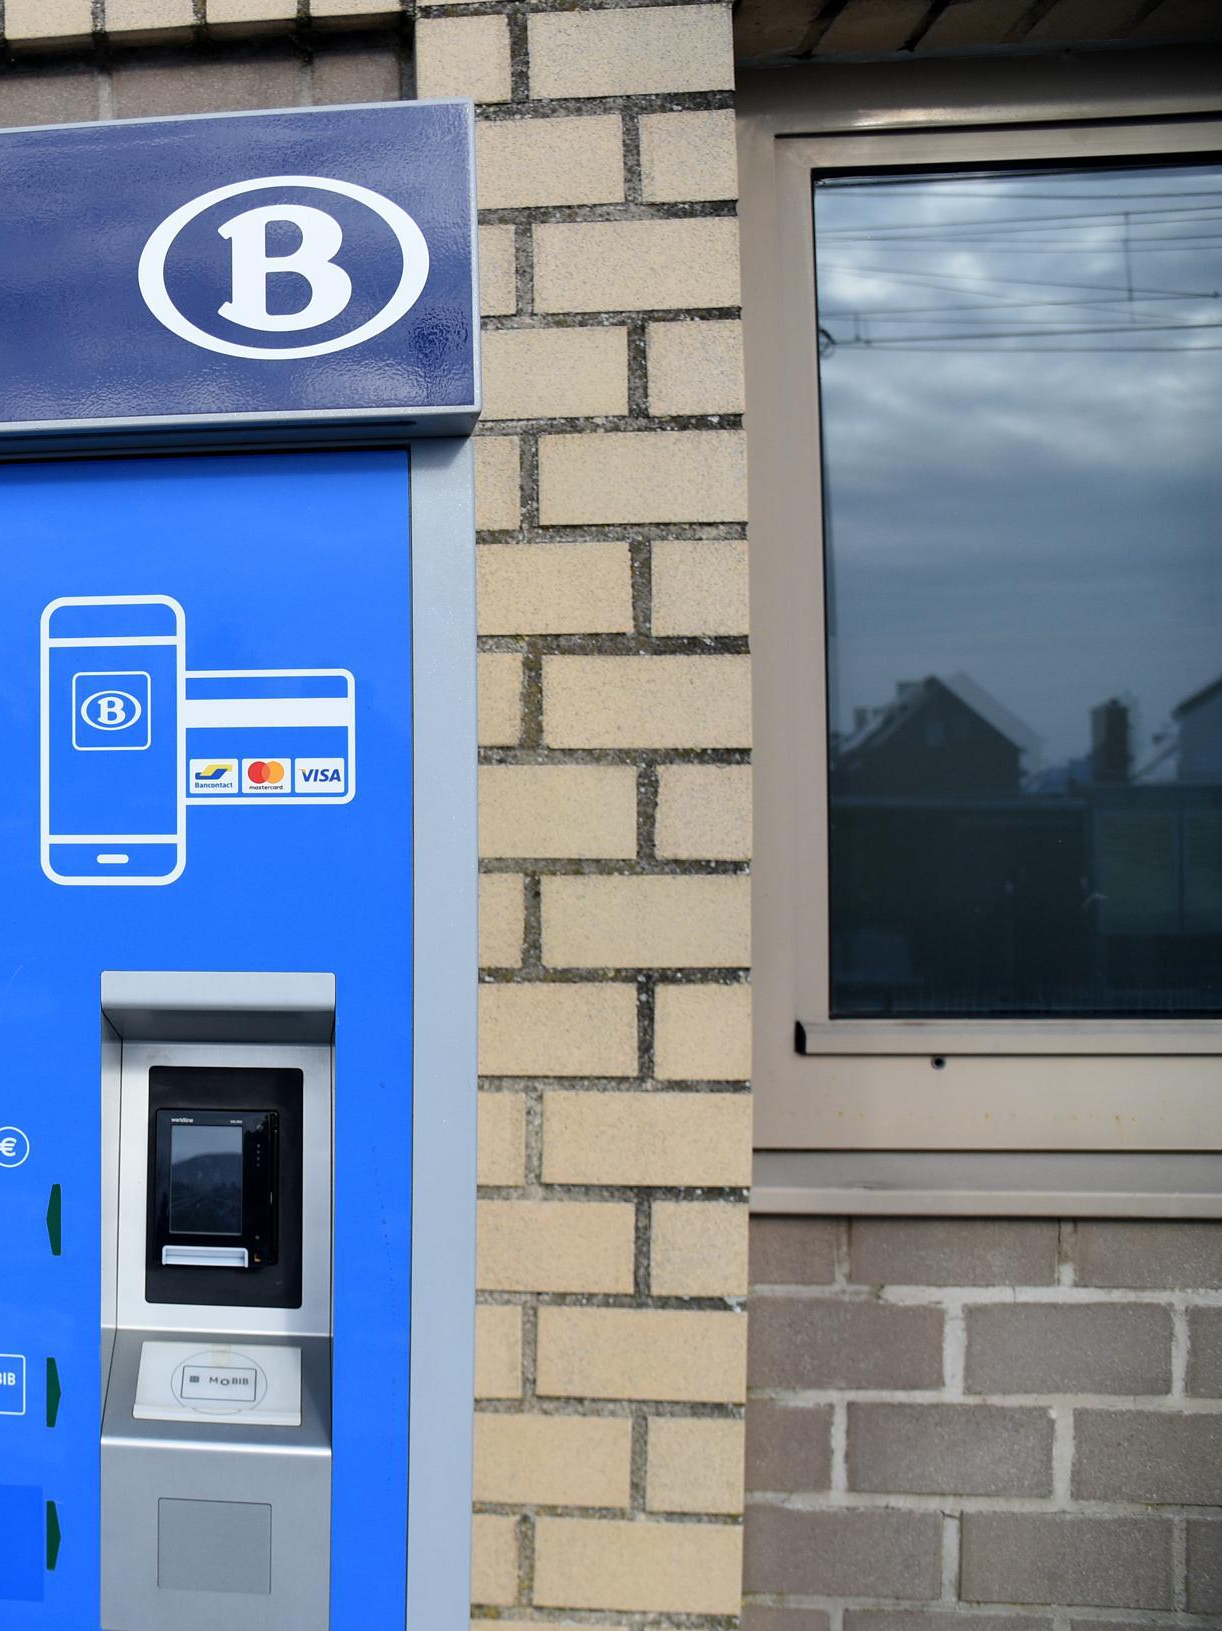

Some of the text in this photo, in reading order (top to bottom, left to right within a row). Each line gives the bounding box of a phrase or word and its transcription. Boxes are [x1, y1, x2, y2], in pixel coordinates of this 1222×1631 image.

[217, 203, 353, 333] B
[301, 768, 342, 783] VISA
[194, 781, 233, 789] Bancontact
